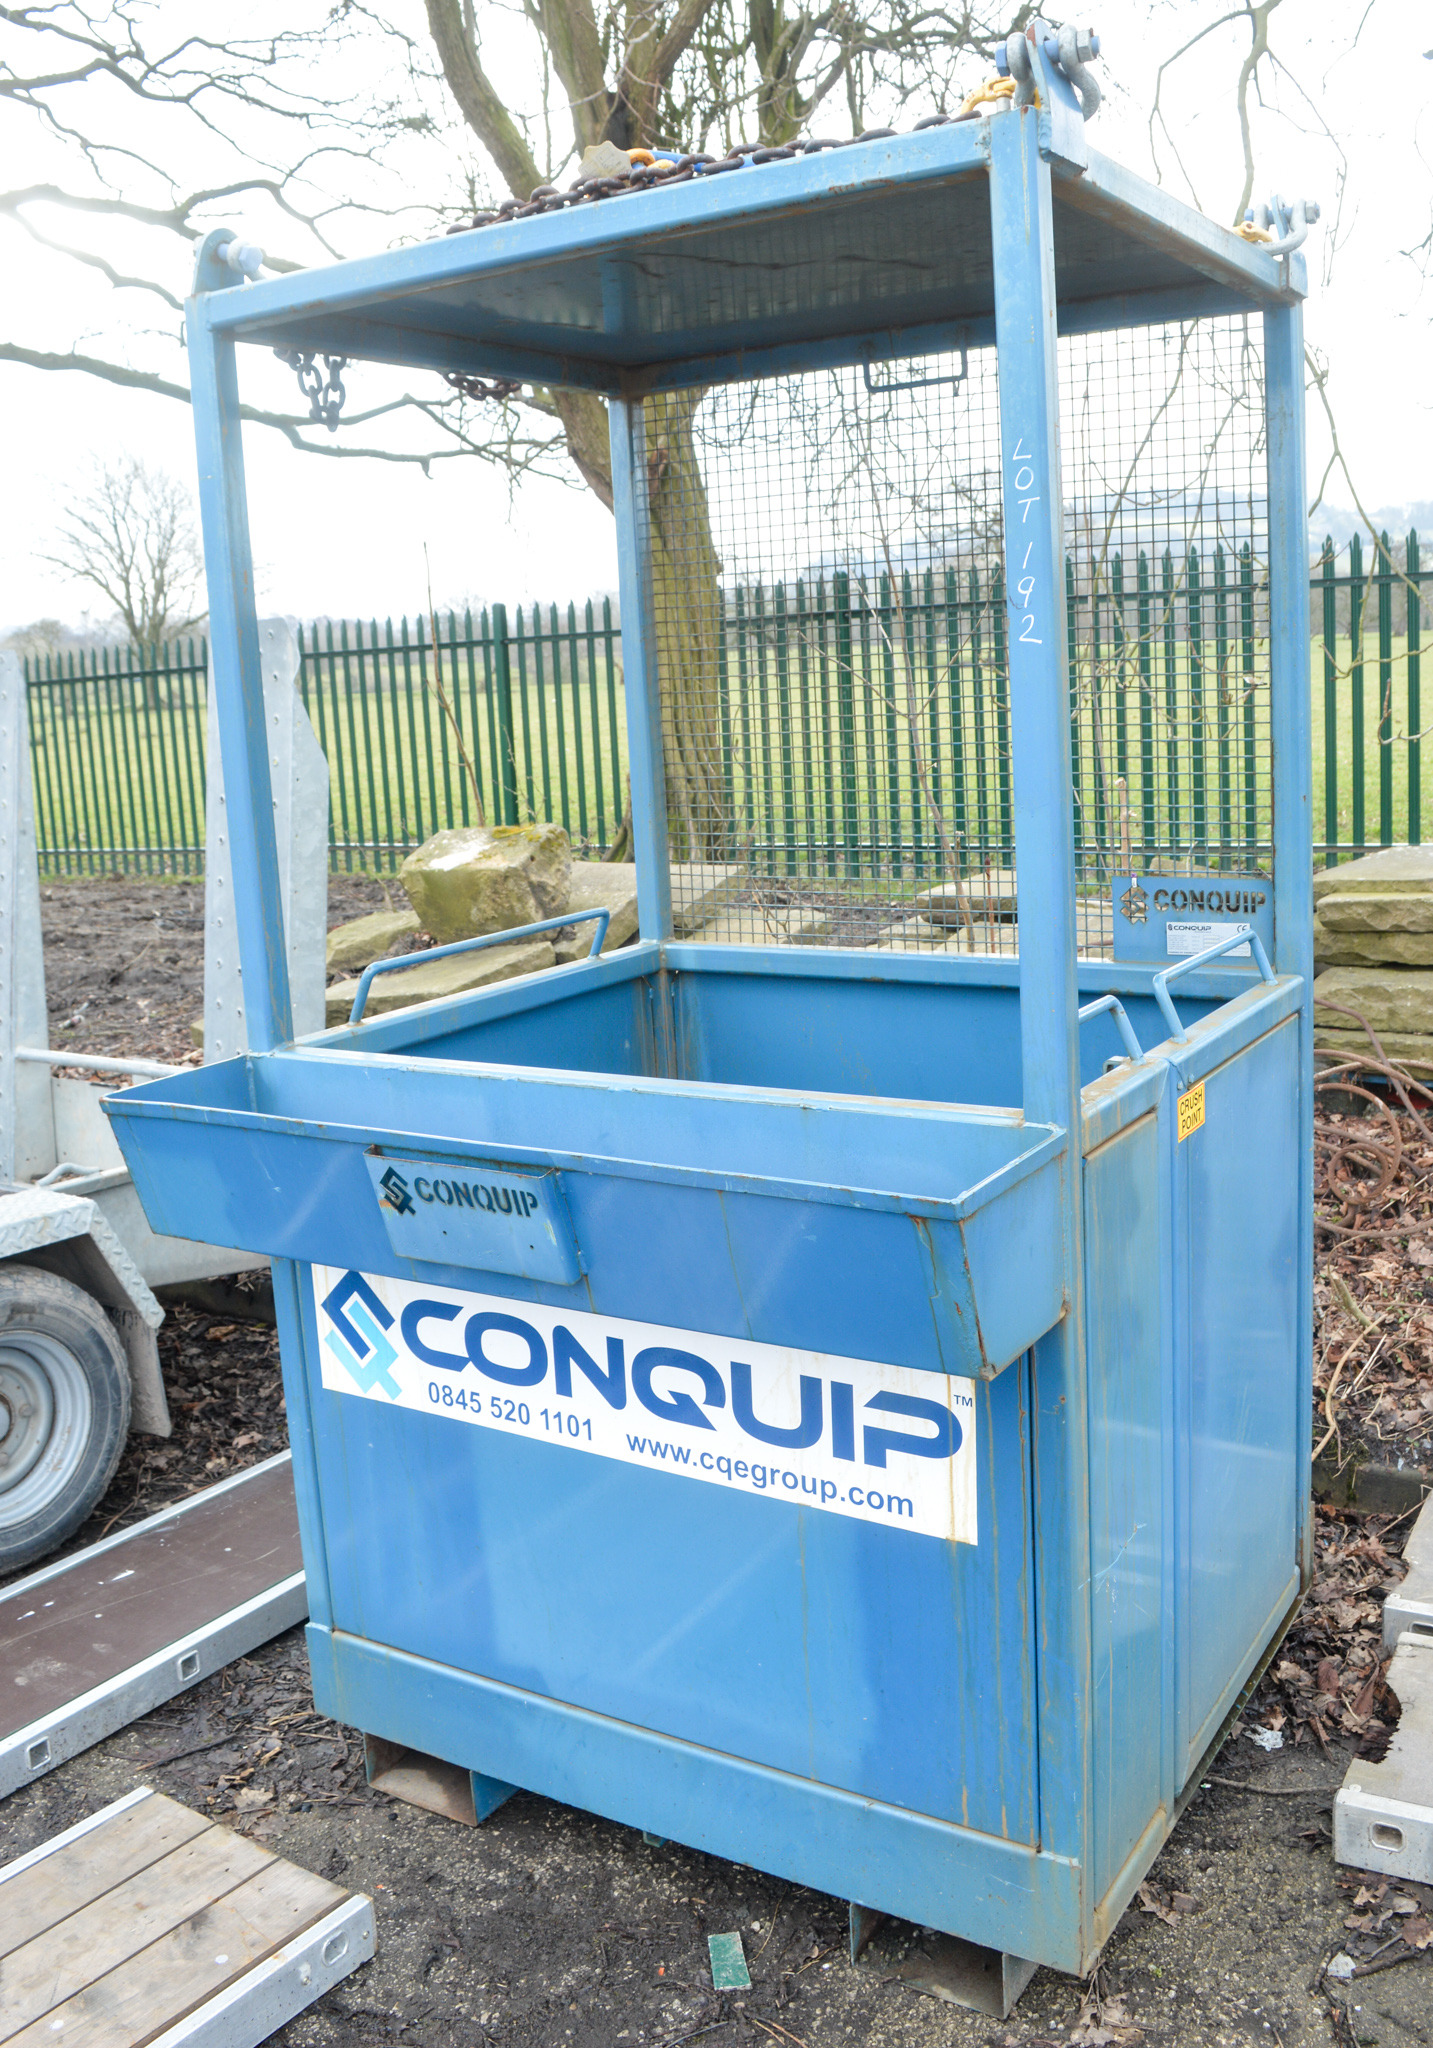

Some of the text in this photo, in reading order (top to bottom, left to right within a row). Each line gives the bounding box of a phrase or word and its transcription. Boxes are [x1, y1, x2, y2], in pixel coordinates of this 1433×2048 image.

[1012, 438, 1042, 644] LOT 192
[1153, 888, 1266, 914] CONQUIP
[1173, 924, 1212, 932] CONQUIP
[1180, 1088, 1203, 1116] CRUSH
[1181, 1107, 1202, 1134] POINT
[413, 1176, 539, 1218] CONQUIP
[400, 1298, 964, 1469] CONQUIP
[428, 1381, 914, 1518] 0845 520 1101 www.cqegroup.com
